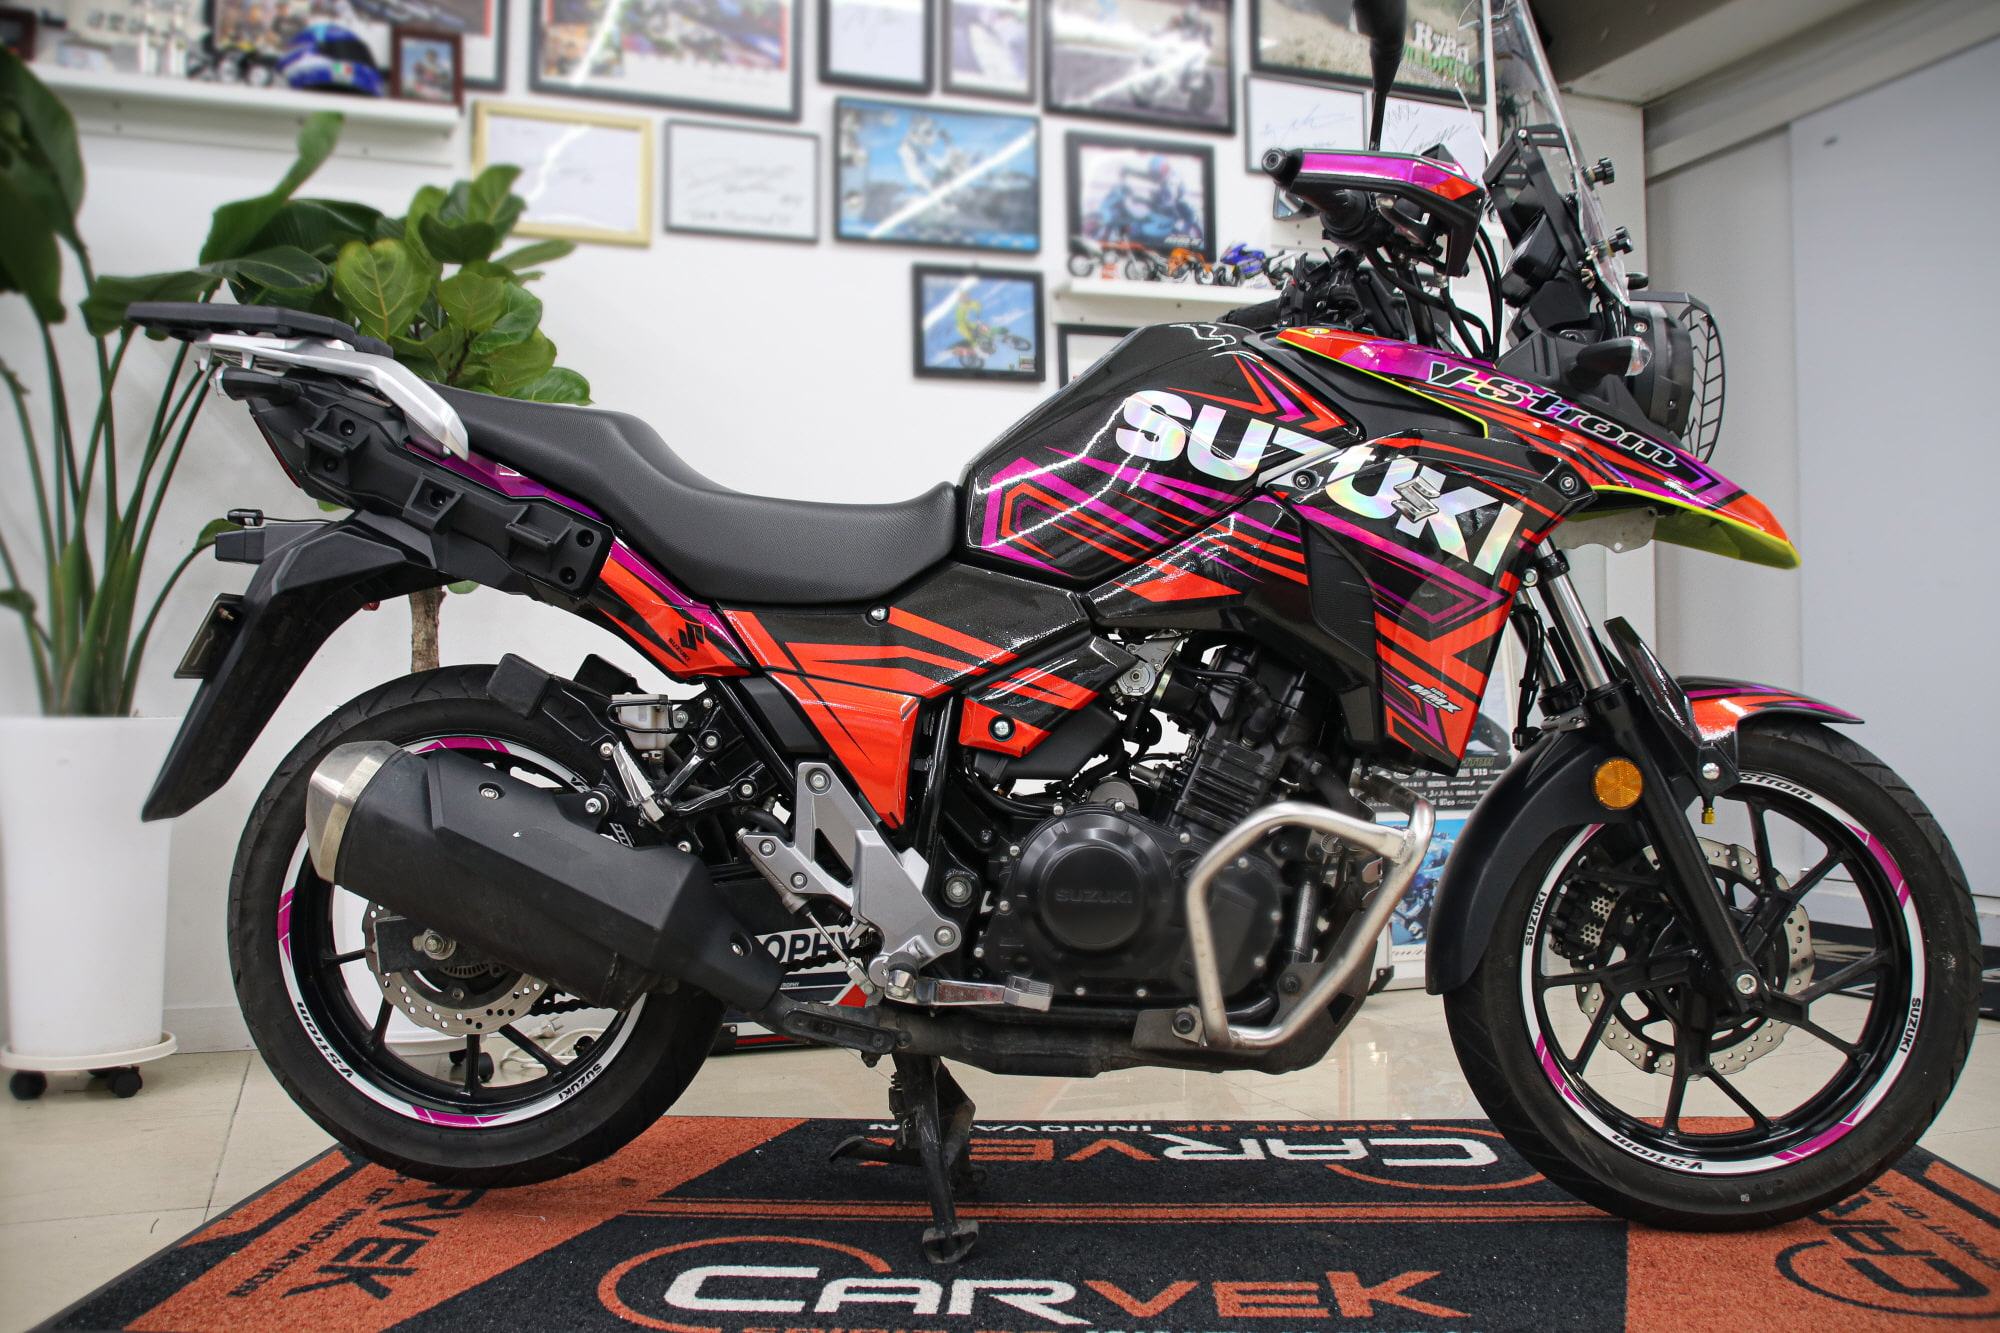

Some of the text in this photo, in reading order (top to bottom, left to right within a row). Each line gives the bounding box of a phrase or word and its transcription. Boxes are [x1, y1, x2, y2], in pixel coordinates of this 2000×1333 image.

[1413, 21, 1470, 65] Ryan
[1425, 361, 1678, 468] V-Strom
[1115, 389, 1524, 576] SUZUKI
[668, 637, 690, 661] SUZUKI
[1055, 888, 1133, 904] SUZUKI
[1524, 891, 1548, 946] SUZUKI
[1899, 997, 1921, 1053] SUZUKI
[558, 1063, 603, 1102] SUZUKI
[663, 1265, 1473, 1325] CARVEK
